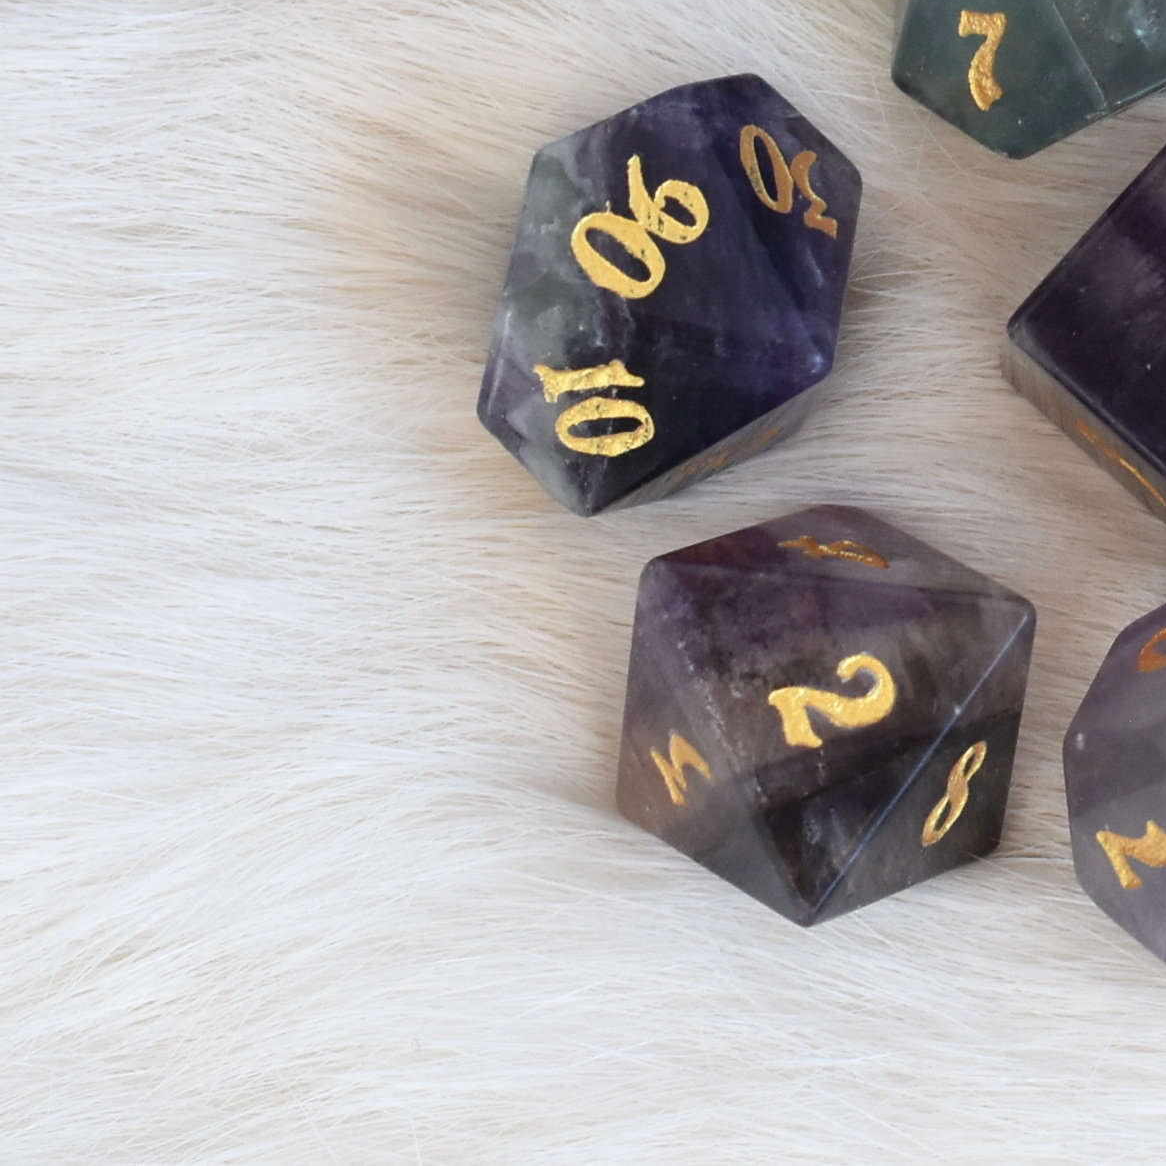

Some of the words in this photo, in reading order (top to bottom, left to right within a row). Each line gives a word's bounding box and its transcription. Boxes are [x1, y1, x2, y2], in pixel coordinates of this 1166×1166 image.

[959, 8, 1009, 112] 7
[739, 124, 838, 240] 30
[533, 358, 655, 457] 10
[768, 653, 899, 751] 2
[921, 740, 988, 849] 8
